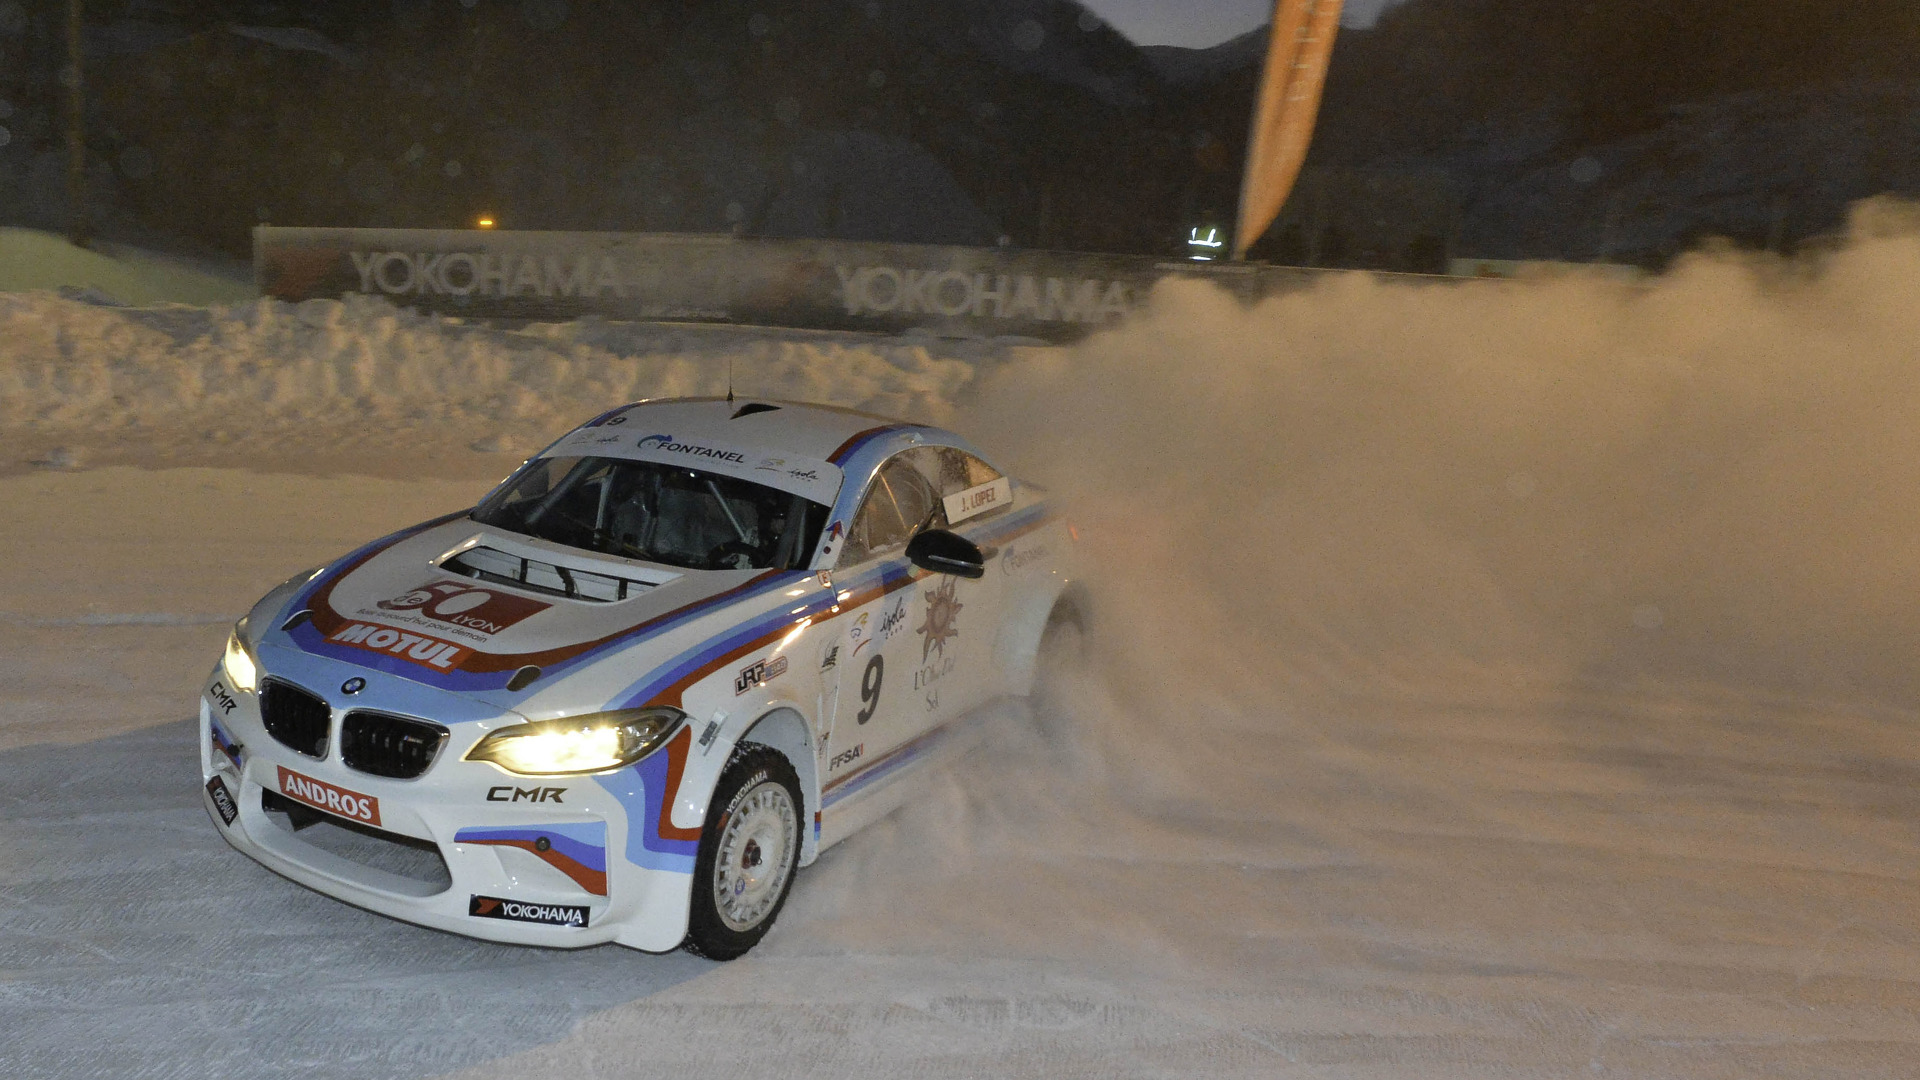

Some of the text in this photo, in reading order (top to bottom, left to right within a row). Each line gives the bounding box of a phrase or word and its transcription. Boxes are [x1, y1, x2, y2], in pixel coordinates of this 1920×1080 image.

[349, 250, 628, 298] YOKOHAMA
[834, 265, 1131, 322] YOKOHAMA
[656, 442, 745, 464] FONTANEL
[961, 487, 996, 512] J. LOPEZ
[451, 614, 502, 633] LYON
[451, 628, 488, 643] demain
[330, 623, 460, 668] MOTUL
[210, 681, 238, 715] CMR
[857, 653, 884, 725] 9
[829, 745, 860, 771] FFSA
[285, 774, 372, 820] ANDROS
[486, 786, 568, 803] CMR
[726, 769, 769, 814] YOKOHAMA
[502, 902, 583, 922] YOKOHAMA
